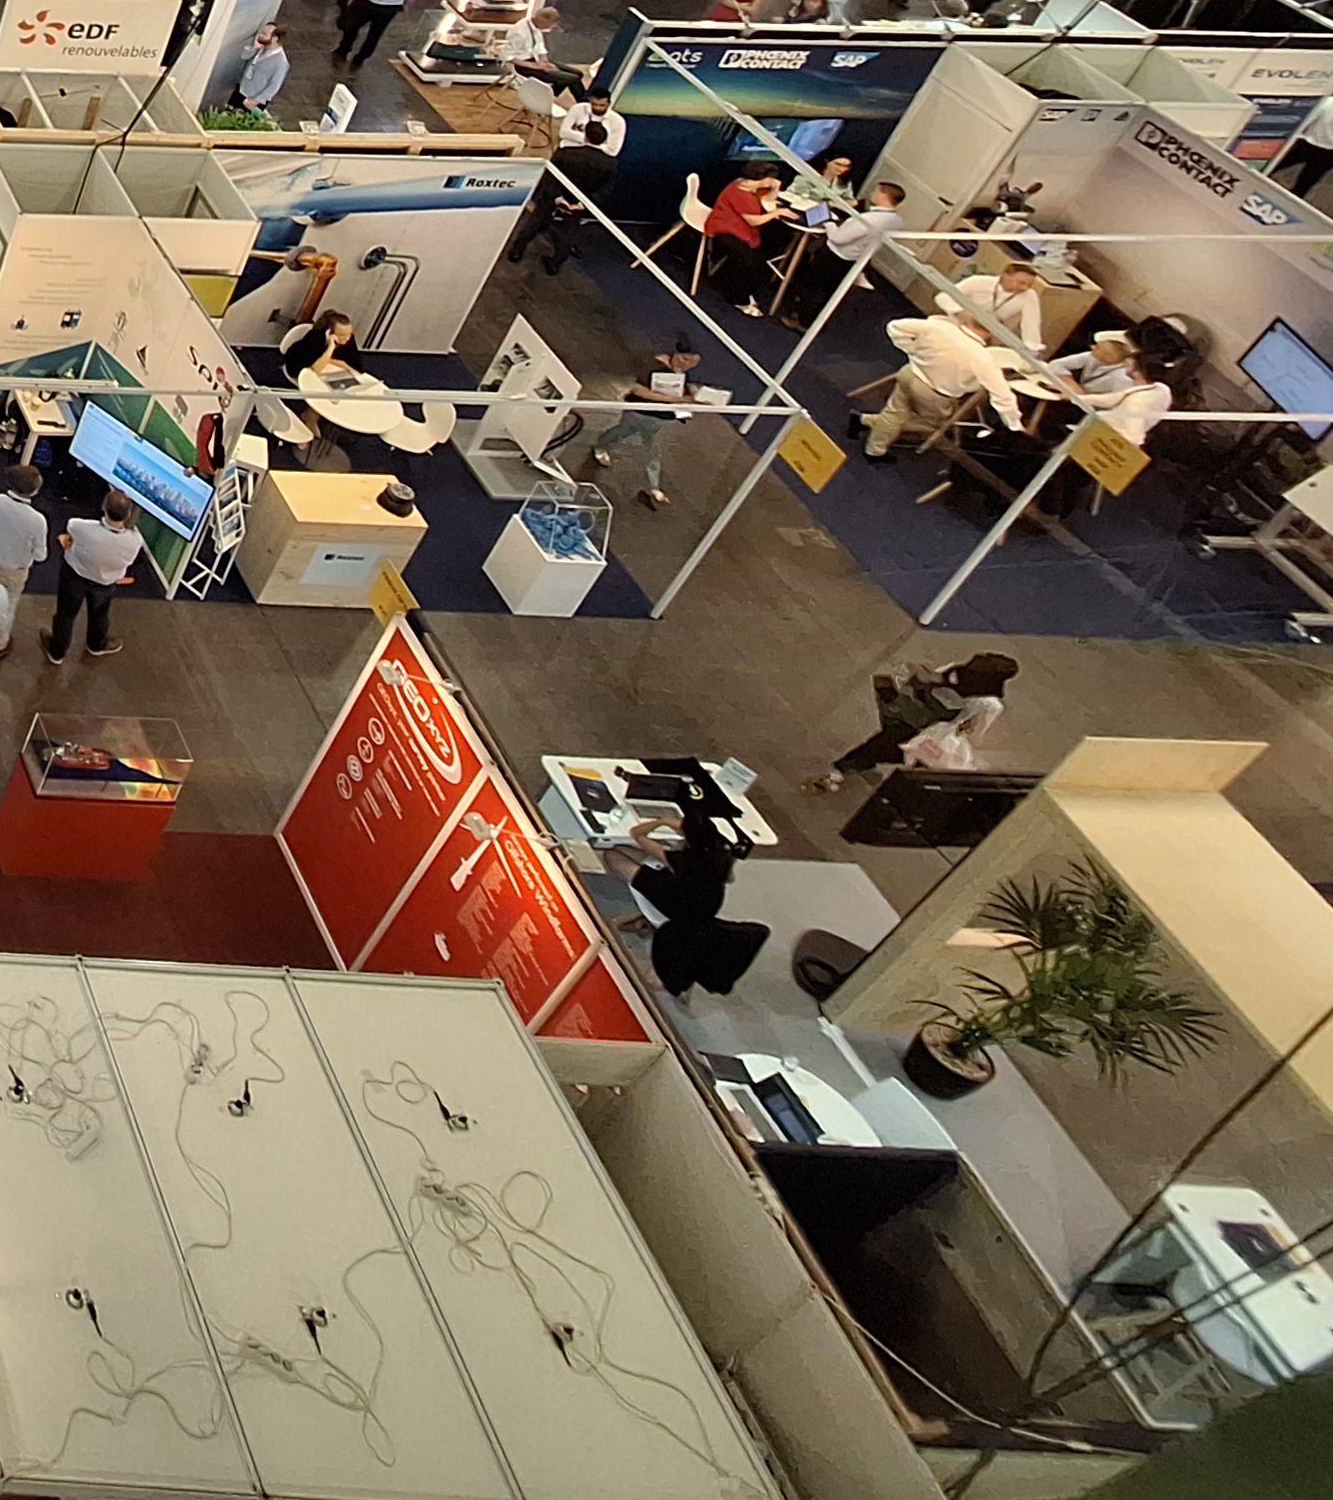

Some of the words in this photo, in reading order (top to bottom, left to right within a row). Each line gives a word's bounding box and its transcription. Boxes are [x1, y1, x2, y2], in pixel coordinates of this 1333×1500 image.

[62, 45, 158, 59] renouvelables
[741, 59, 807, 69] CONTACT
[830, 54, 868, 68] SAP
[1157, 144, 1234, 198] CONTACT
[465, 177, 517, 189] Roxtec
[1242, 194, 1289, 225] SAP
